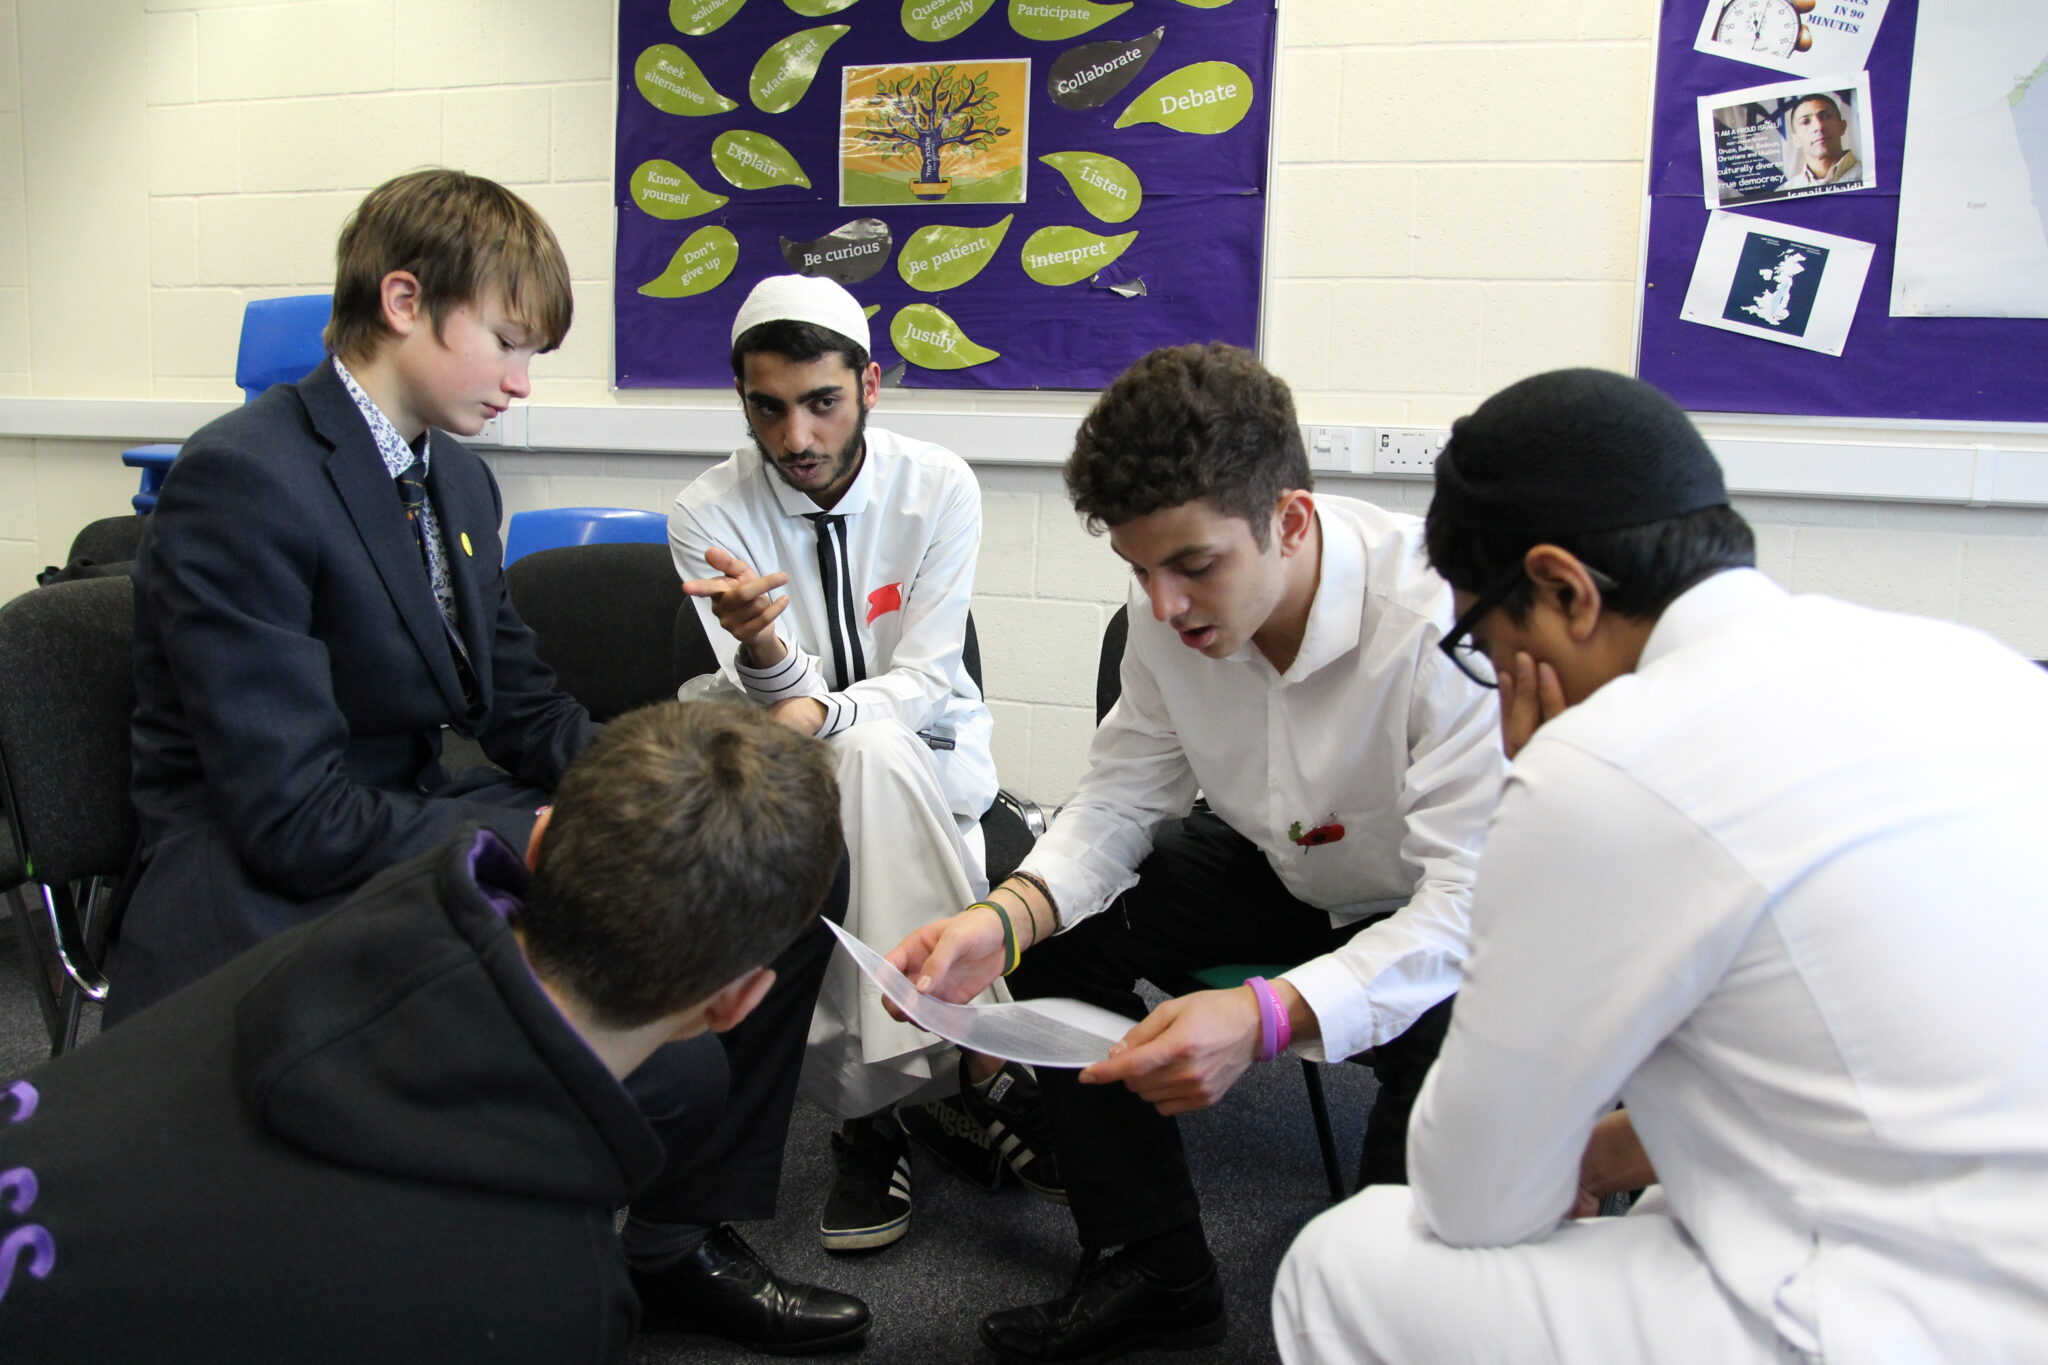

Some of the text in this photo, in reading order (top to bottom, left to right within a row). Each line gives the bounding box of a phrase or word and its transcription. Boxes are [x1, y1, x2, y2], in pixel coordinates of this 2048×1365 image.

[931, 0, 974, 29] deeply
[1017, 3, 1090, 20] Participate
[1807, 14, 1860, 33] MINUTES
[1834, 5, 1865, 19] IN 90
[657, 59, 686, 80] Seek
[1057, 46, 1142, 95] Collaborate
[644, 71, 705, 105] alternatives
[1159, 83, 1238, 115] Debate
[1721, 129, 1730, 137] AM
[726, 142, 779, 179] Explain
[1717, 163, 1754, 176] culturally
[647, 171, 682, 188] Know
[1079, 166, 1128, 200] Listen
[1718, 180, 1737, 189] true
[1738, 174, 1785, 186] democracy
[642, 186, 691, 206] yourself
[684, 240, 716, 265] Don't
[804, 240, 881, 267] Be curious
[909, 236, 987, 275] Be patient
[1029, 240, 1107, 269] Interpret
[680, 256, 721, 287] give up
[903, 322, 957, 353] Justify
